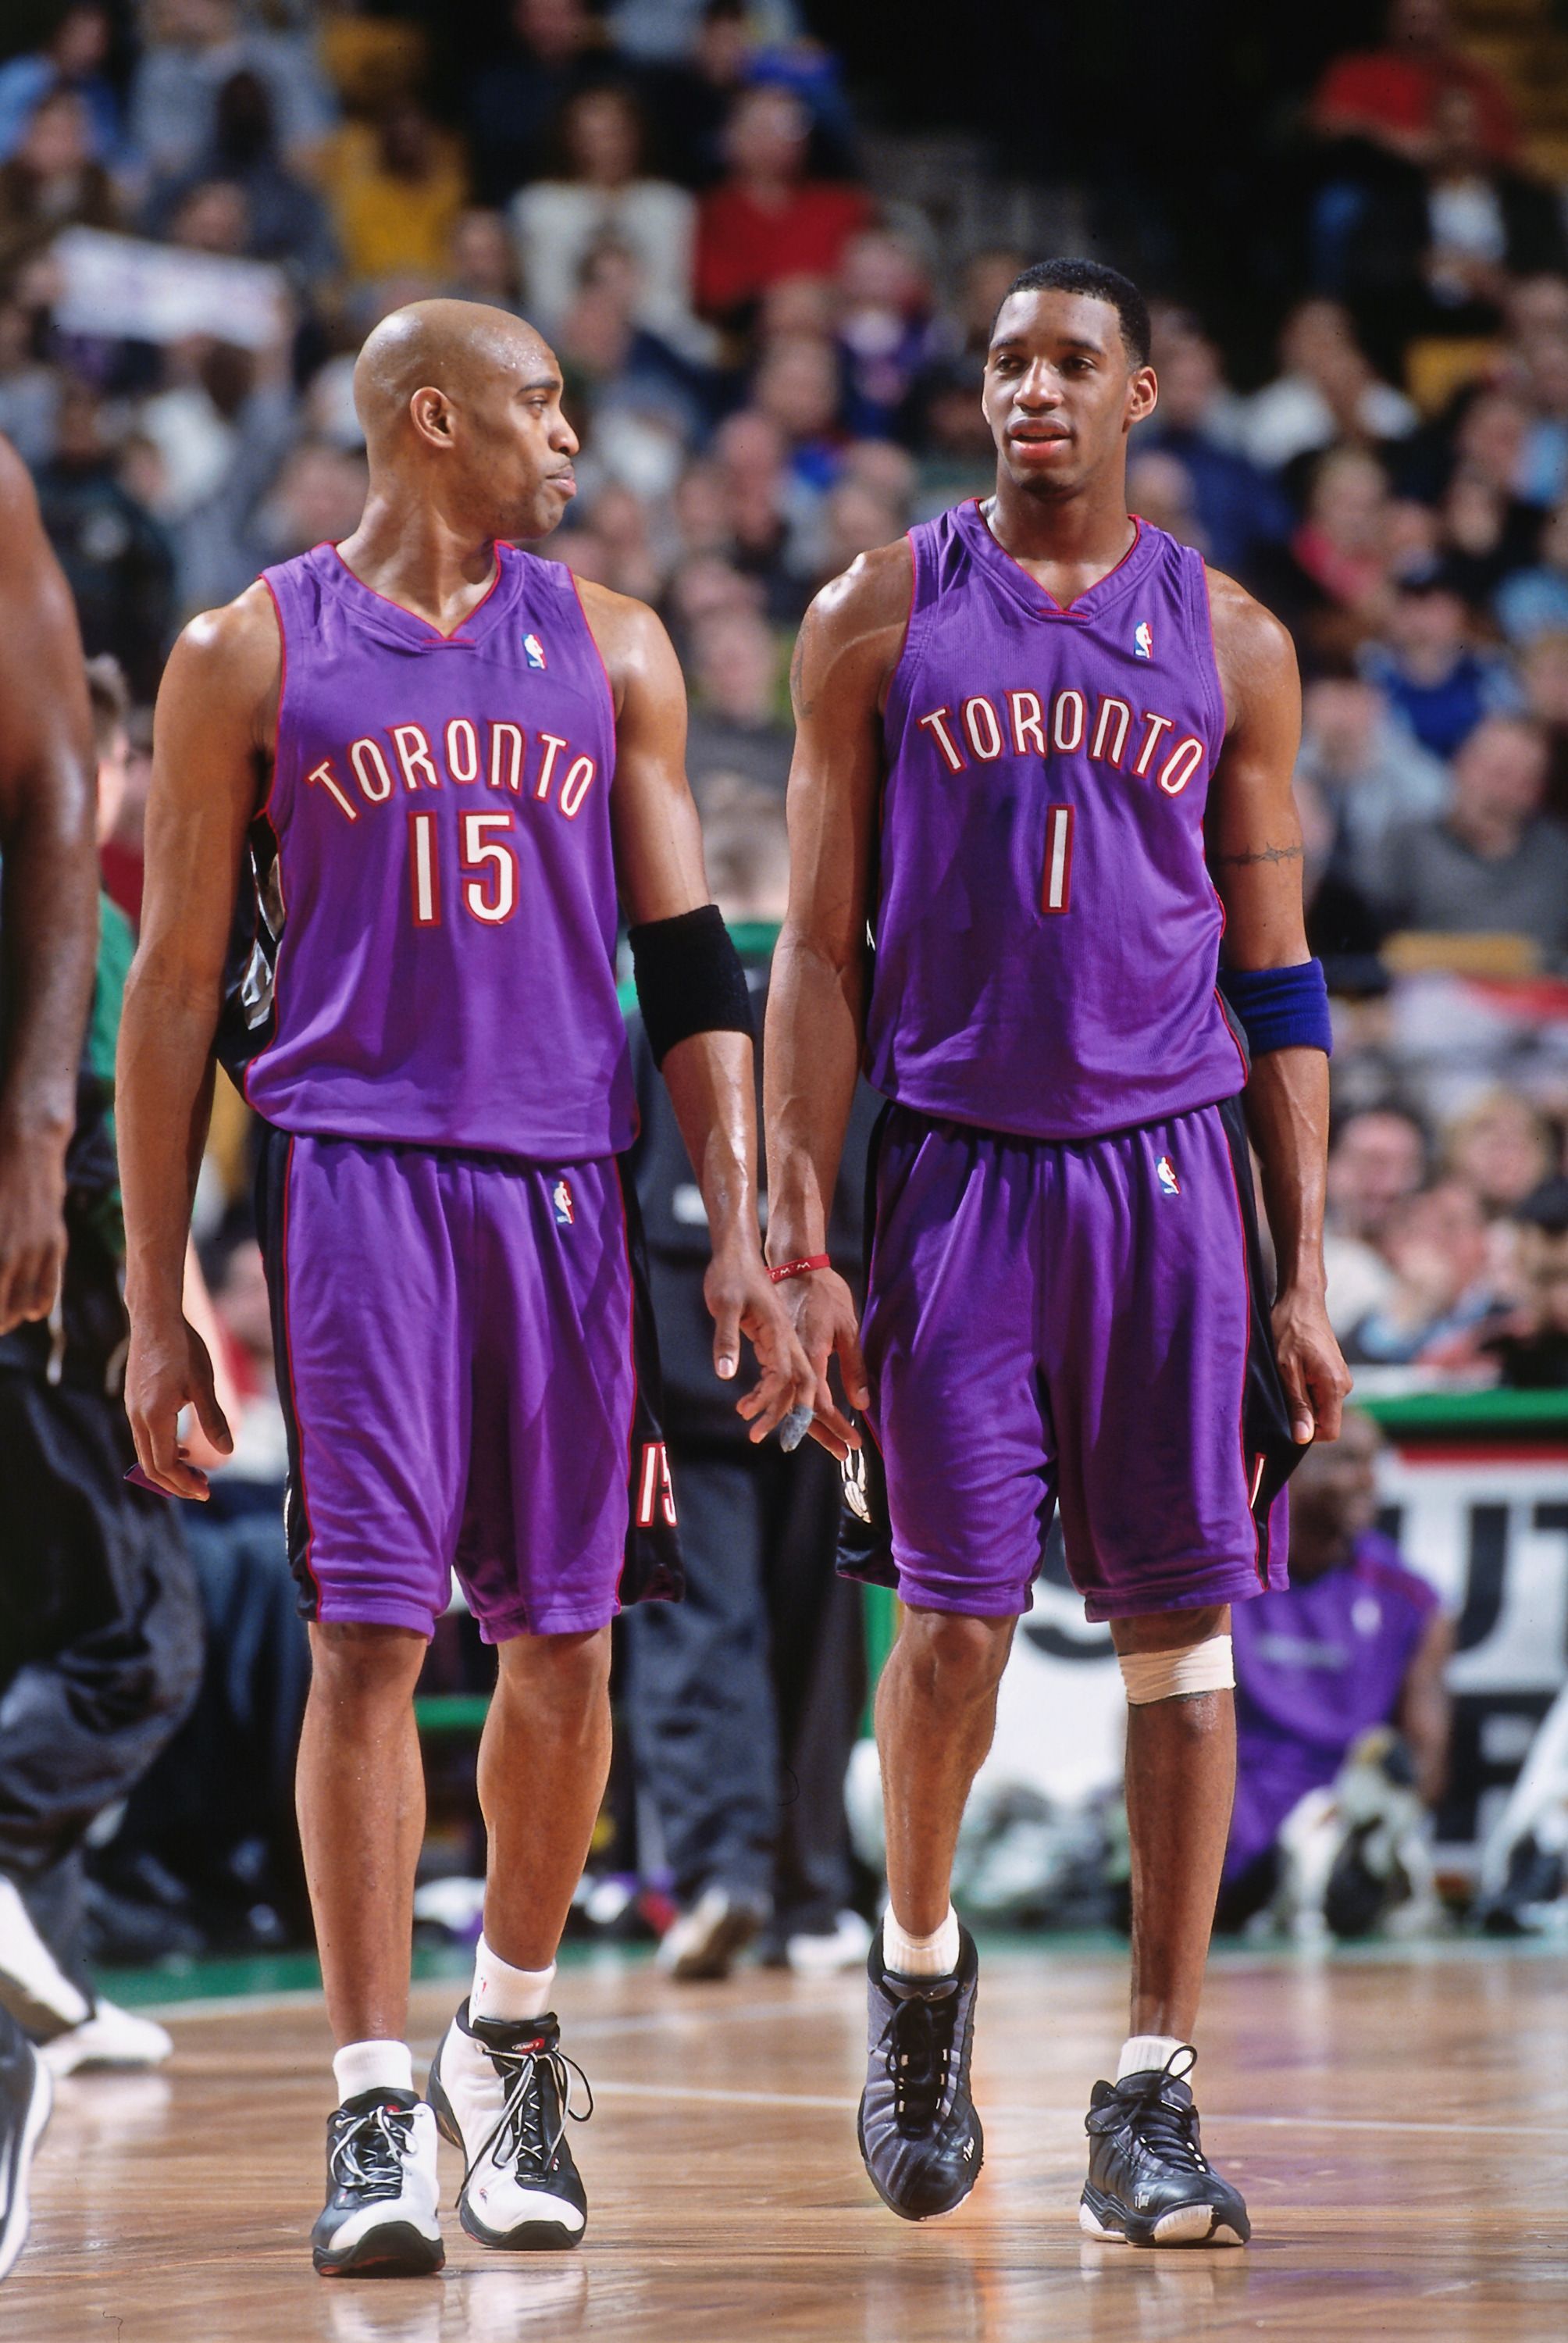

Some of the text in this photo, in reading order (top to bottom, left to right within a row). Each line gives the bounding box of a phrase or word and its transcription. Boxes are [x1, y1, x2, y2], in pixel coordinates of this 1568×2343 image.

[305, 717, 597, 822] TORONTO
[918, 689, 1205, 798] TORONTO
[409, 811, 519, 927] 15
[1042, 804, 1075, 914] 1
